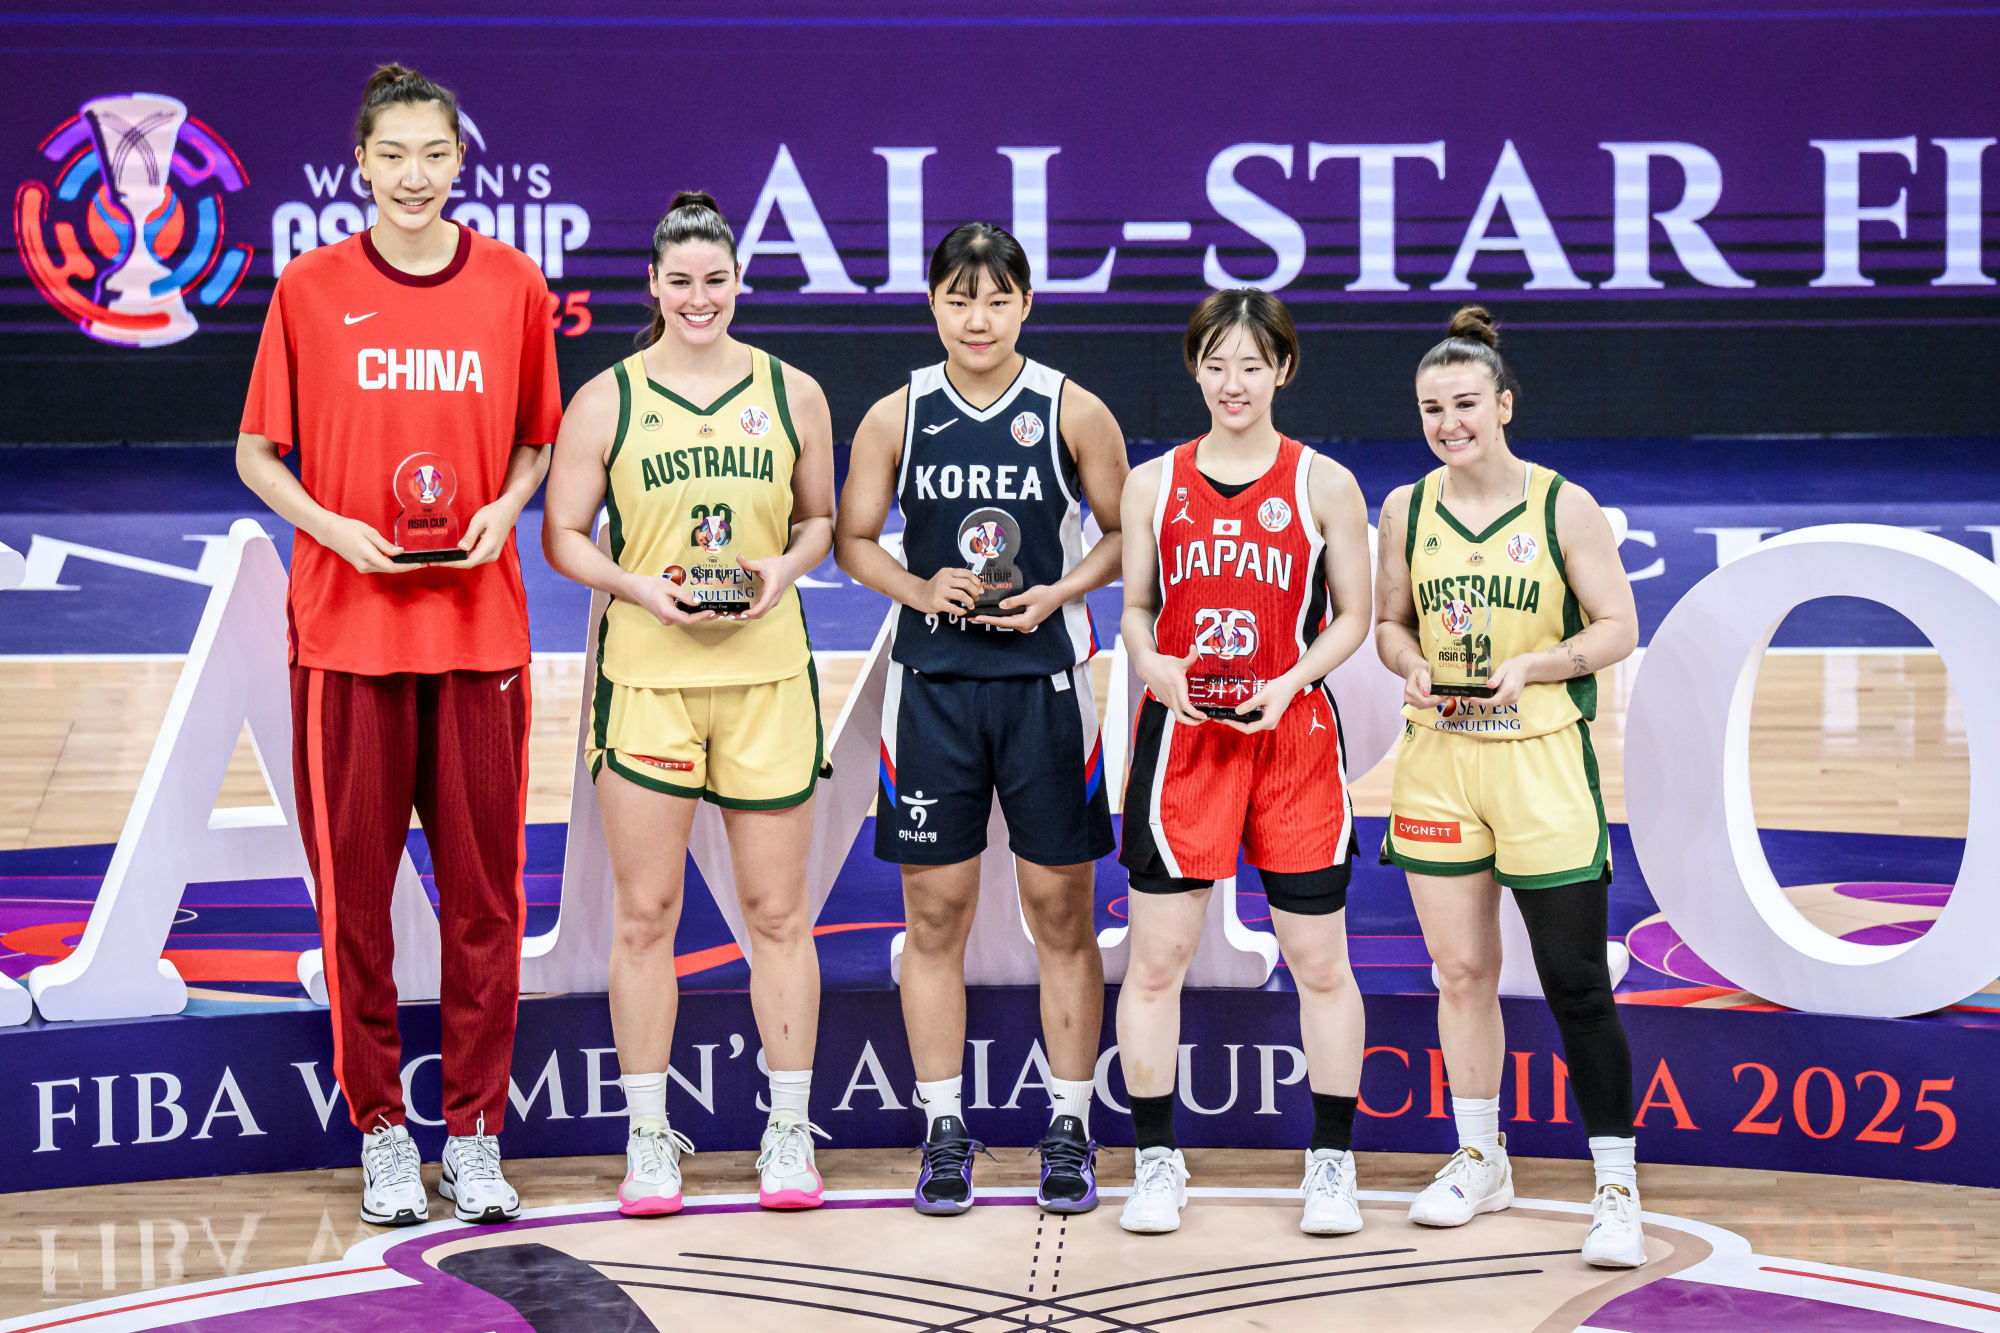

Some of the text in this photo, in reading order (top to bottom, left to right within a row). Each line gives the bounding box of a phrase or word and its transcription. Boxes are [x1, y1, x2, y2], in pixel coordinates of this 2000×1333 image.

[357, 347, 485, 393] CHINA
[641, 446, 774, 491] AUSTRALIA
[915, 464, 1043, 500] KOREA
[1169, 539, 1293, 592] JAPAN
[693, 586, 755, 602] SULTING
[1418, 574, 1540, 616] AUSTRALIA
[1195, 608, 1256, 656] 26
[1461, 633, 1491, 677] 12
[1435, 718, 1521, 732] CONSULTING
[898, 829, 937, 843] 하나은행
[1399, 822, 1452, 837] CYGNETT
[32, 1065, 267, 1154] FIBA
[832, 1038, 1054, 1112] AIA
[1732, 1061, 1957, 1151] 2025
